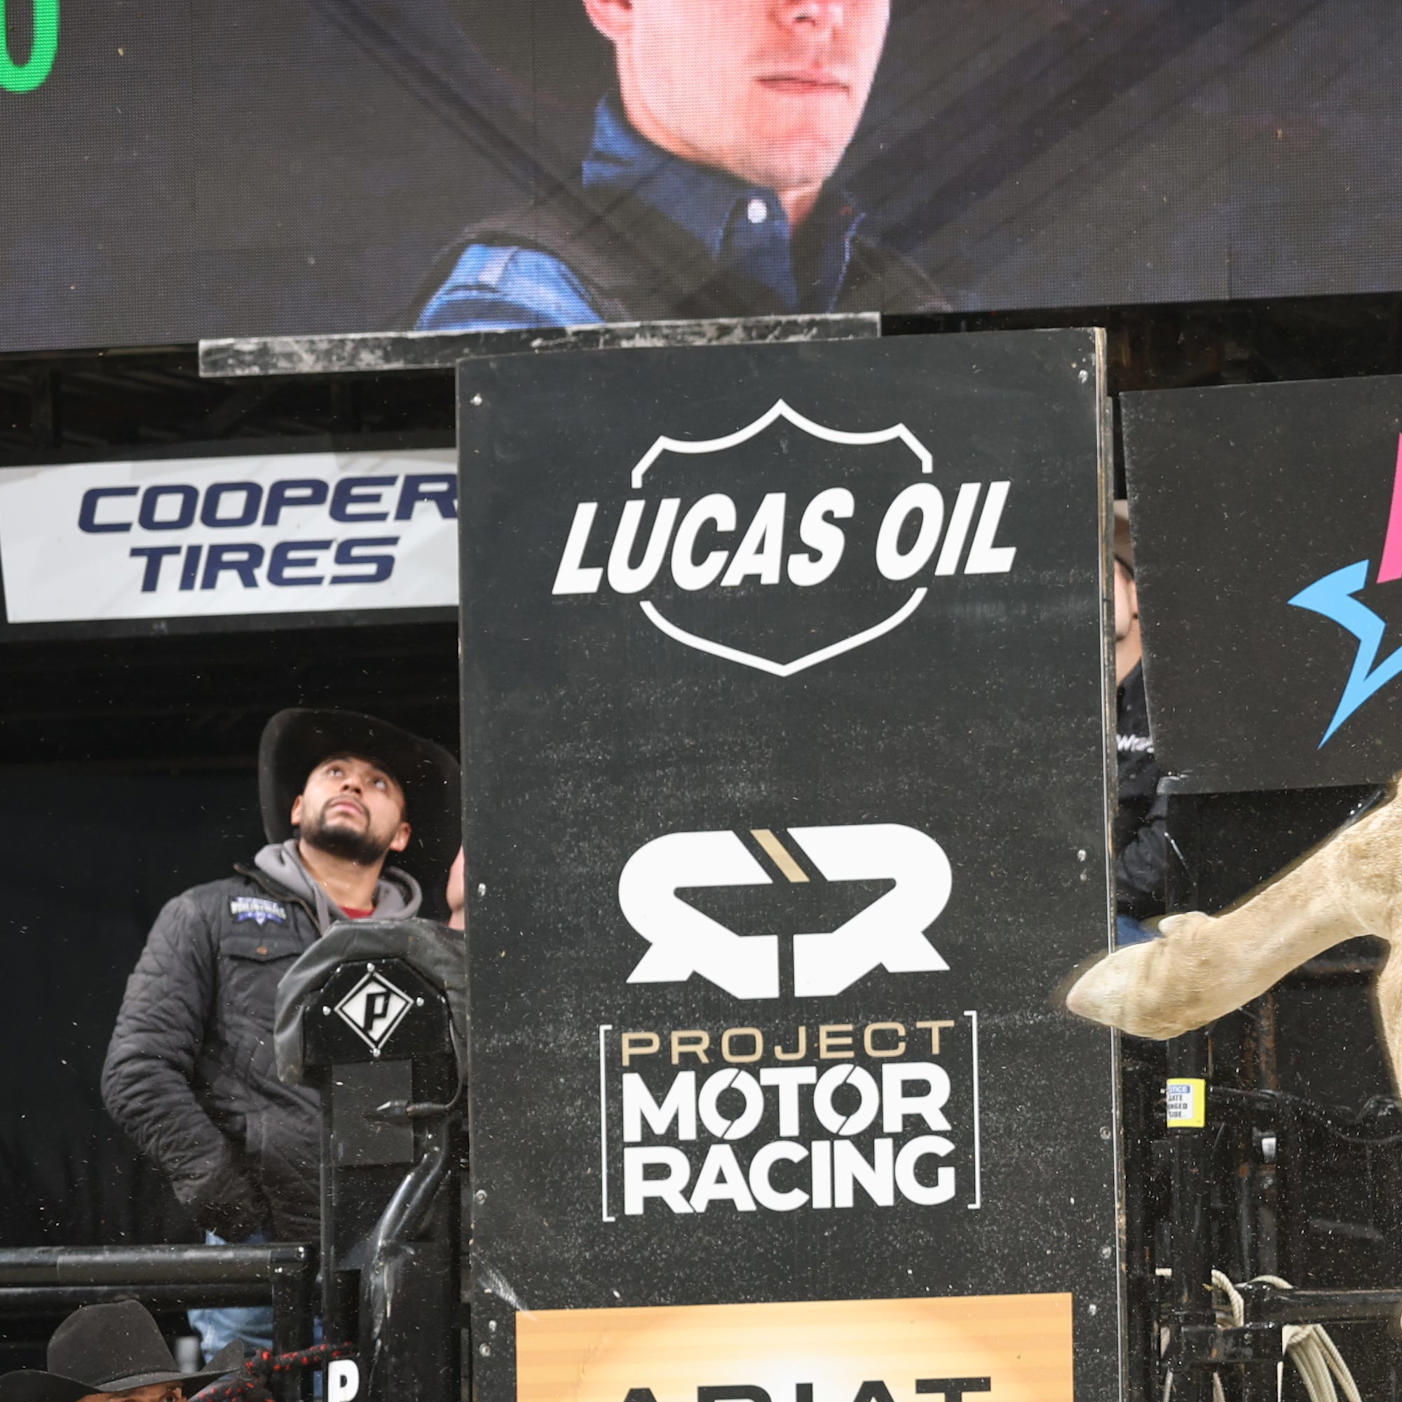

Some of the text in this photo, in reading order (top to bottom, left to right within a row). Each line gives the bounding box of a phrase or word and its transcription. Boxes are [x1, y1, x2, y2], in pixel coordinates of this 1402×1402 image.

[78, 473, 456, 534] COOPER
[552, 481, 1017, 595] LUCAS OIL
[130, 536, 400, 593] TIRES
[622, 1020, 955, 1067] PROJECT
[622, 1061, 952, 1143] MOTOR
[623, 1135, 956, 1216] RACING
